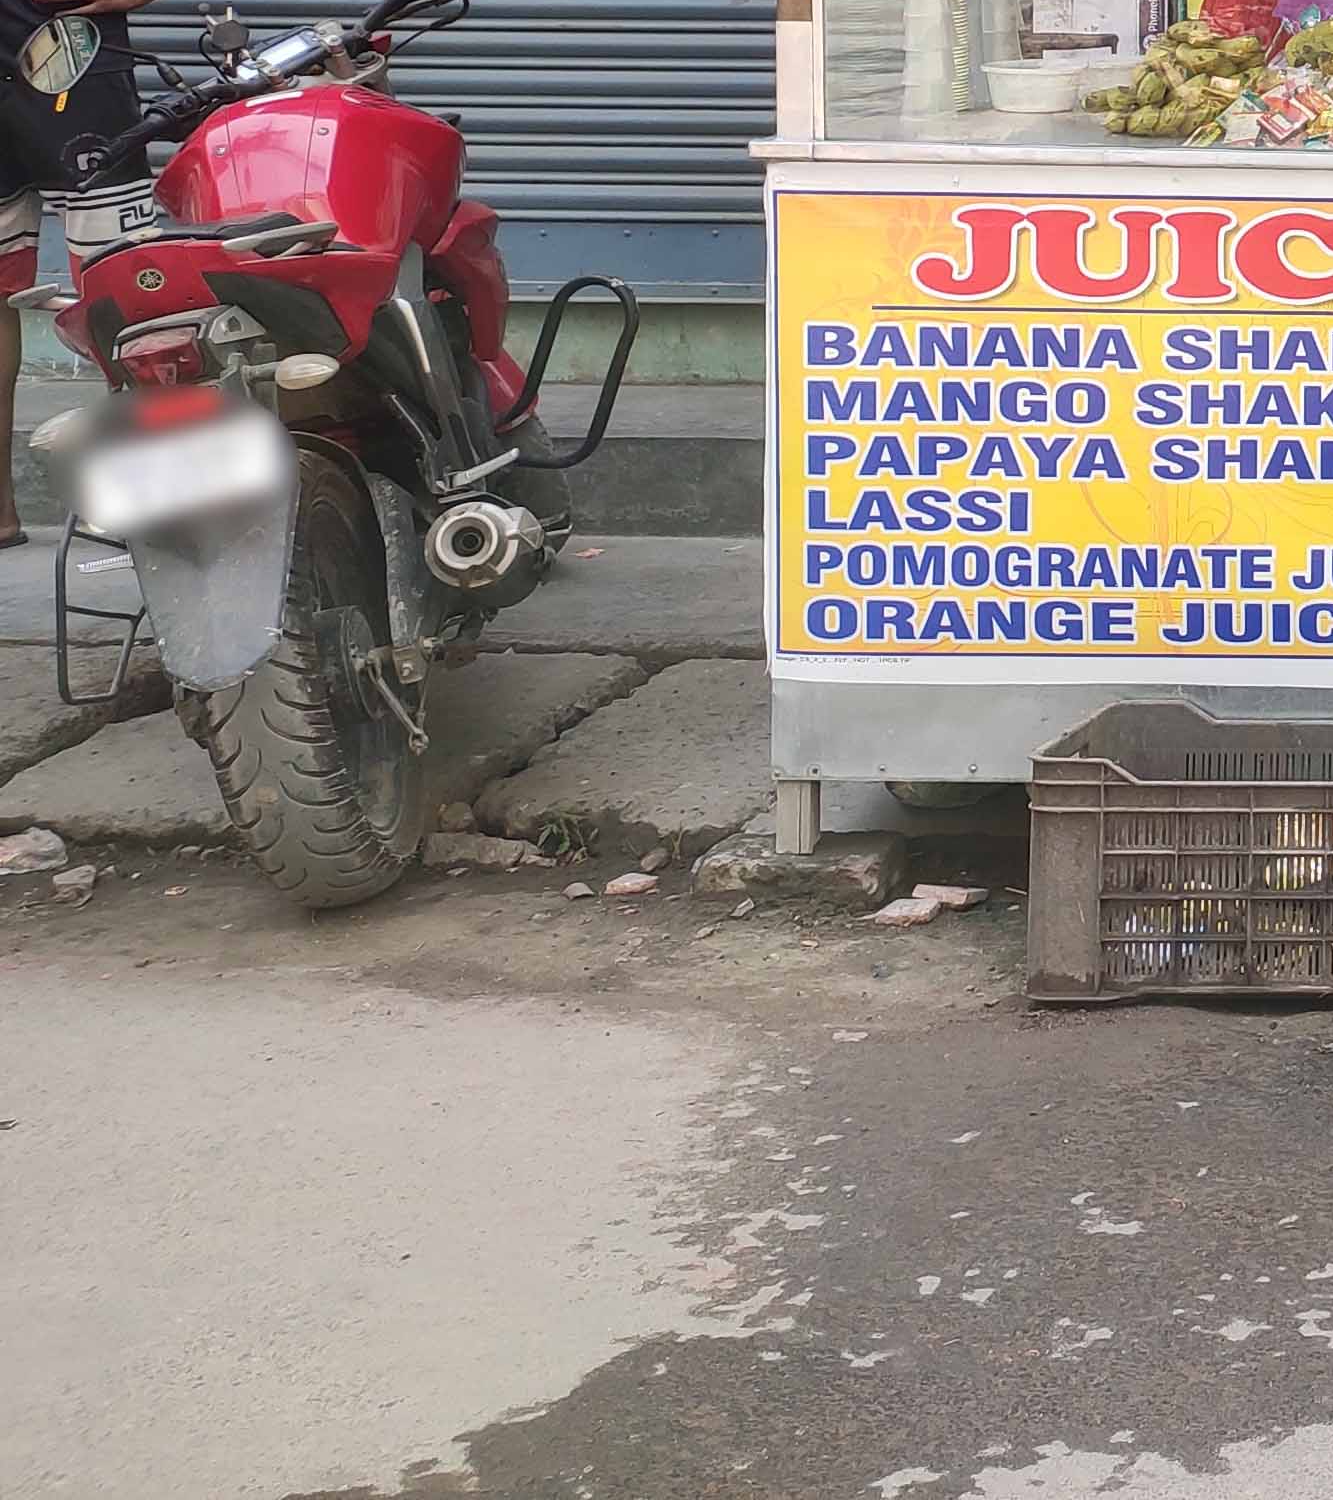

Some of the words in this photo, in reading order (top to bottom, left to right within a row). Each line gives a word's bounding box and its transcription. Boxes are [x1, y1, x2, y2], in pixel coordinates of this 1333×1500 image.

[805, 326, 1136, 370] BANANA
[806, 381, 1107, 426] MANGO
[806, 435, 1127, 480] PAPAYA
[806, 488, 1030, 534] LASSI
[805, 544, 1273, 591] POMOGRANATE
[805, 598, 1135, 643] ORANGE
